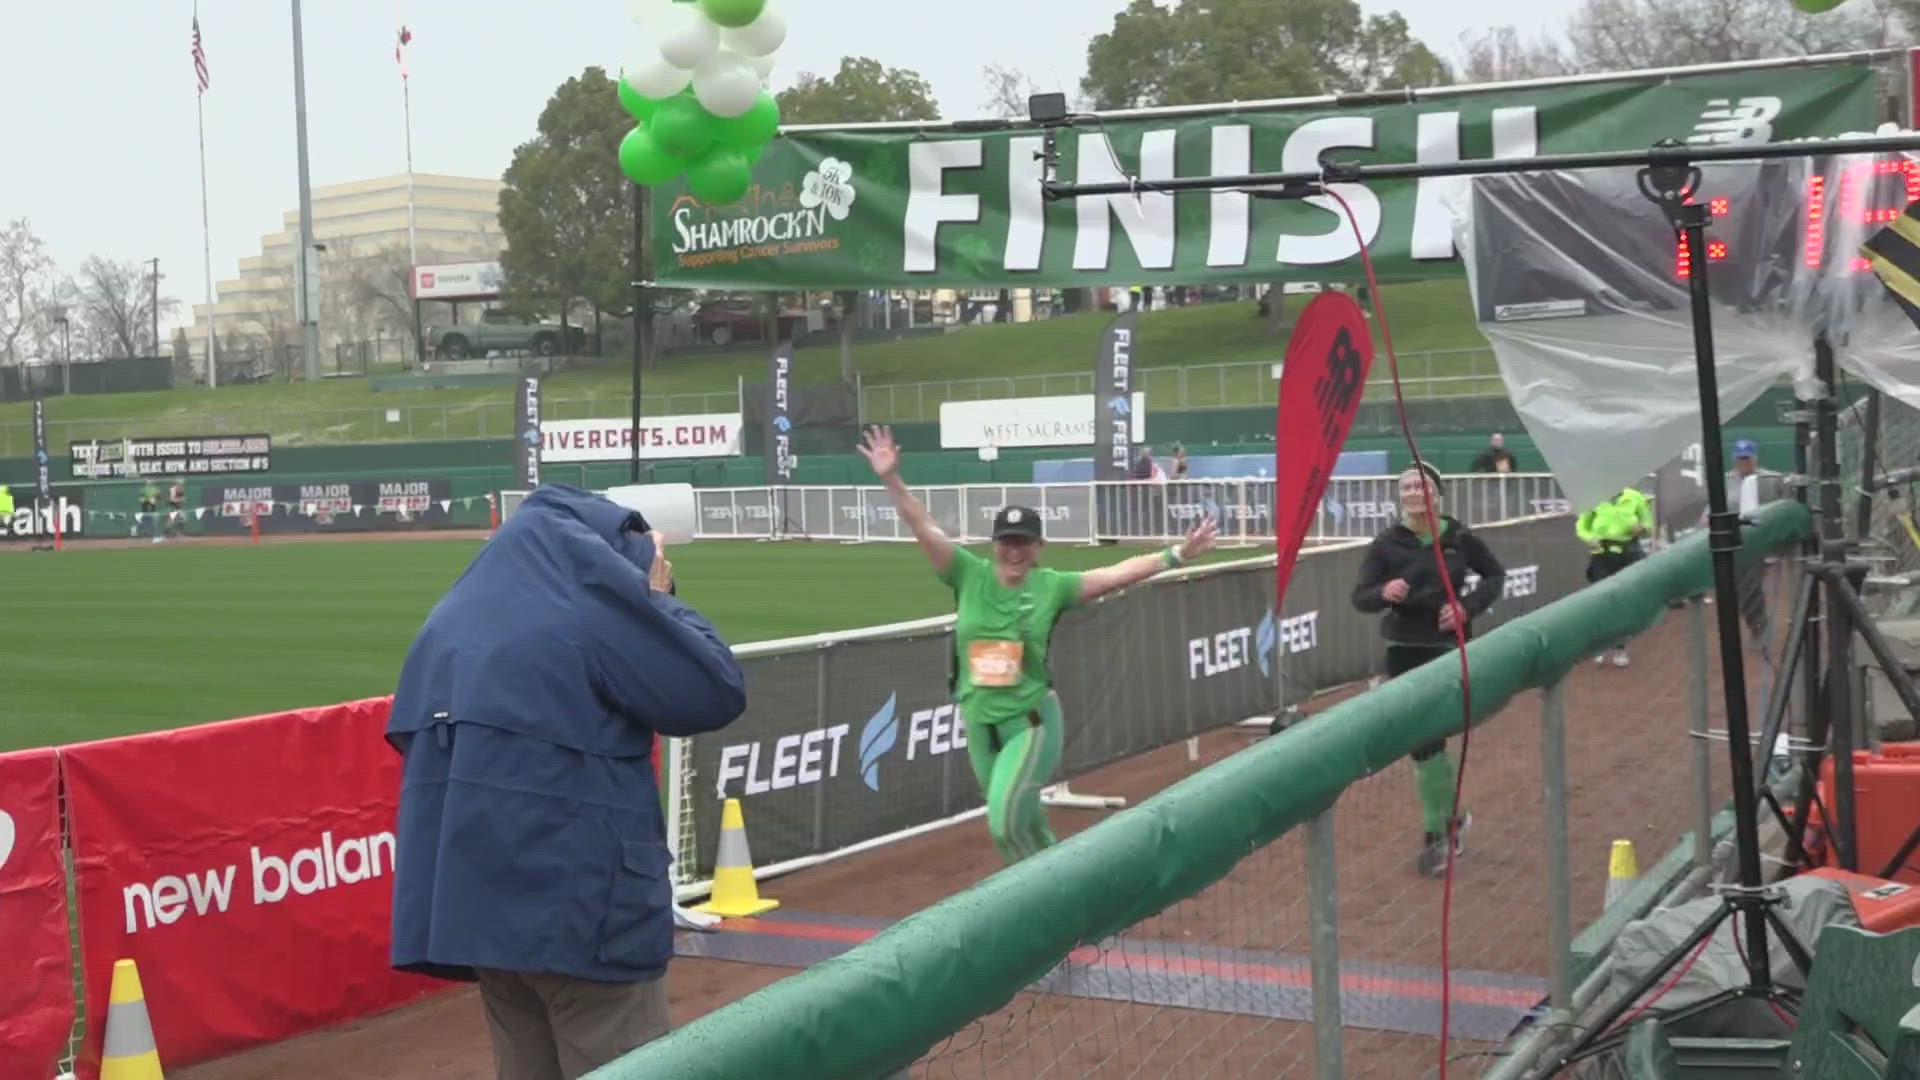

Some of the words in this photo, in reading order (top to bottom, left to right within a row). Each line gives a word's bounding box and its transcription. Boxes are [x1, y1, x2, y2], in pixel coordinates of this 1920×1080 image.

[776, 358, 788, 412] FLEET
[1113, 328, 1131, 392] FLEET
[527, 378, 539, 427] FLEET
[983, 423, 1020, 440] WEST
[1112, 420, 1129, 471] FEET
[300, 485, 349, 499] MAJOR
[380, 482, 428, 496] MAJOR
[528, 447, 539, 488] FEET
[224, 487, 272, 500] MAJOR
[1189, 626, 1250, 681] FLEET
[1279, 609, 1320, 657] FEET
[716, 723, 850, 800] FLEET
[123, 864, 237, 934] new
